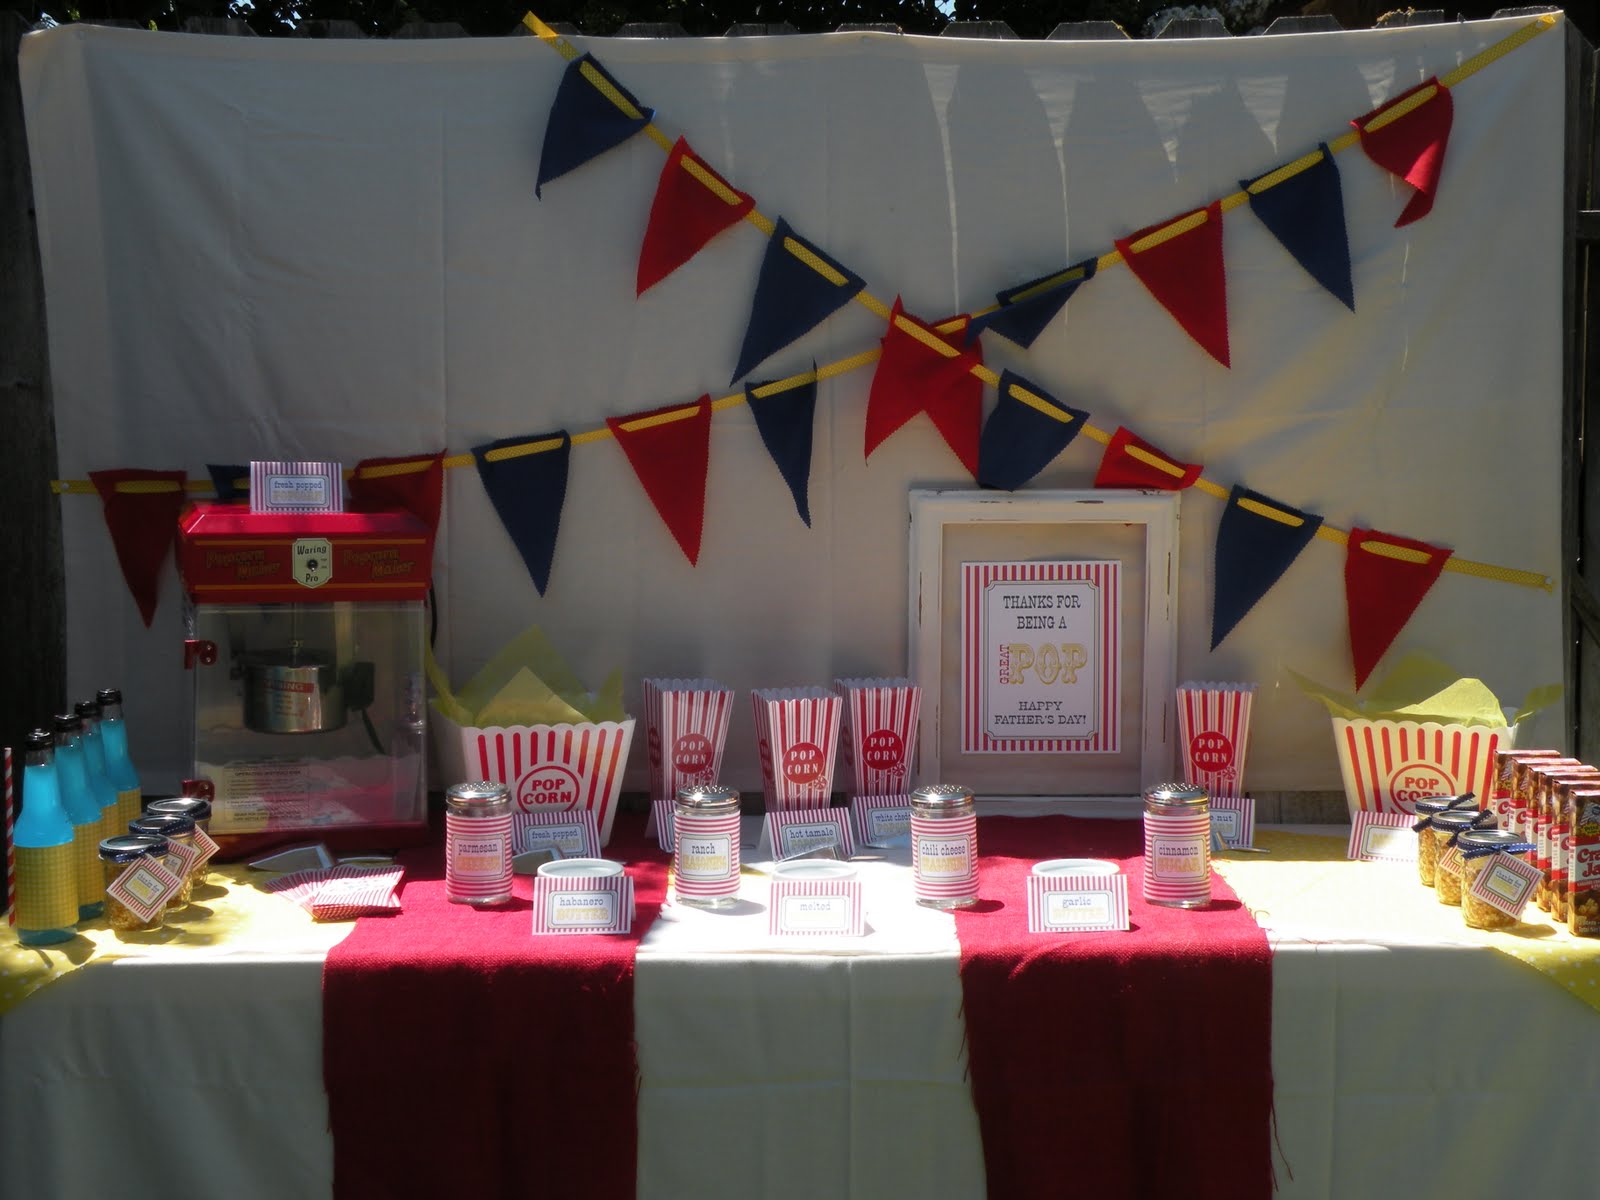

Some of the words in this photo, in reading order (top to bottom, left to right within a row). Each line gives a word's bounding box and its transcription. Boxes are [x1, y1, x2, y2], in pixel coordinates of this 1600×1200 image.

[296, 480, 323, 490] popped
[297, 545, 327, 555] Waring
[305, 573, 319, 582] Pro
[1003, 595, 1054, 609] THANKS
[1057, 595, 1081, 609] FOR
[1017, 616, 1055, 629] BEING
[1058, 616, 1067, 629] A
[1000, 644, 1010, 684] GREAT
[1009, 643, 1088, 685] POP
[1018, 701, 1063, 711] HAPPY
[994, 714, 1055, 725] FATHER'S
[1058, 714, 1087, 725] DAY!
[680, 741, 705, 751] POP
[870, 737, 895, 747] POP
[1198, 738, 1224, 749] POP
[675, 754, 707, 765] CORN
[790, 750, 816, 761] POP
[866, 750, 898, 762] CORN
[1195, 752, 1227, 763] CORN
[787, 763, 819, 775] CORN
[531, 779, 566, 791] POP
[1404, 776, 1440, 790] POP
[522, 791, 572, 805] CORN
[532, 831, 551, 840] fresh
[552, 829, 578, 840] popped
[789, 829, 804, 839] hot
[805, 827, 834, 838] tamale
[458, 842, 498, 855] parmesan
[691, 843, 716, 854] ranch
[922, 844, 938, 856] chili
[941, 844, 966, 856] cheese
[1158, 844, 1199, 856] cinnamon
[559, 896, 604, 906] habanero
[799, 902, 831, 911] melted
[1062, 896, 1092, 908] garlic
